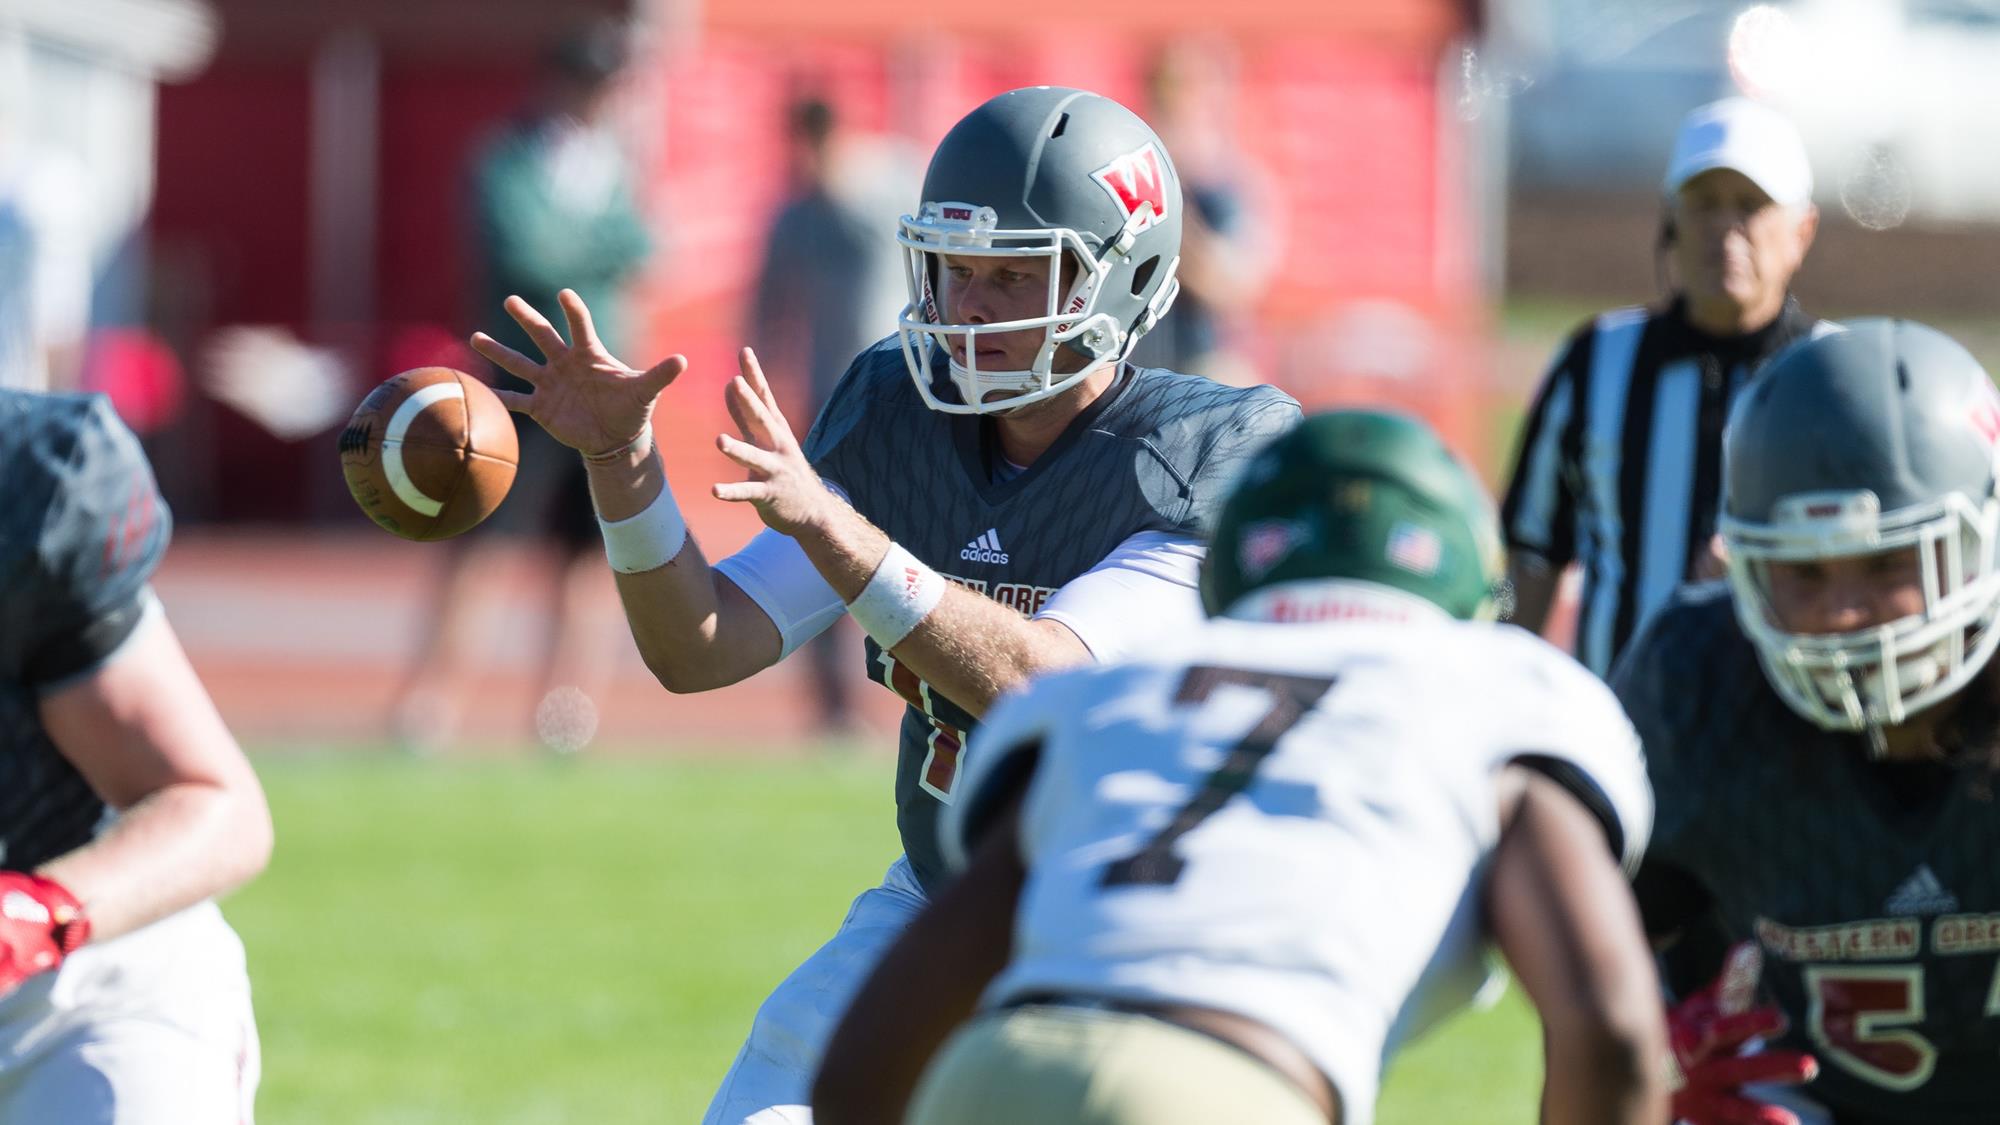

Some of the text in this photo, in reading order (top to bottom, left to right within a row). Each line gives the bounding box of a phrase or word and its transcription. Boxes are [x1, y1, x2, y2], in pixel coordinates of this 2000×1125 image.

[1088, 141, 1168, 236] W
[960, 548, 1009, 565] adidas
[993, 583, 1062, 621] ORE
[1097, 665, 1338, 887] 7
[1804, 955, 2000, 1091] 5
